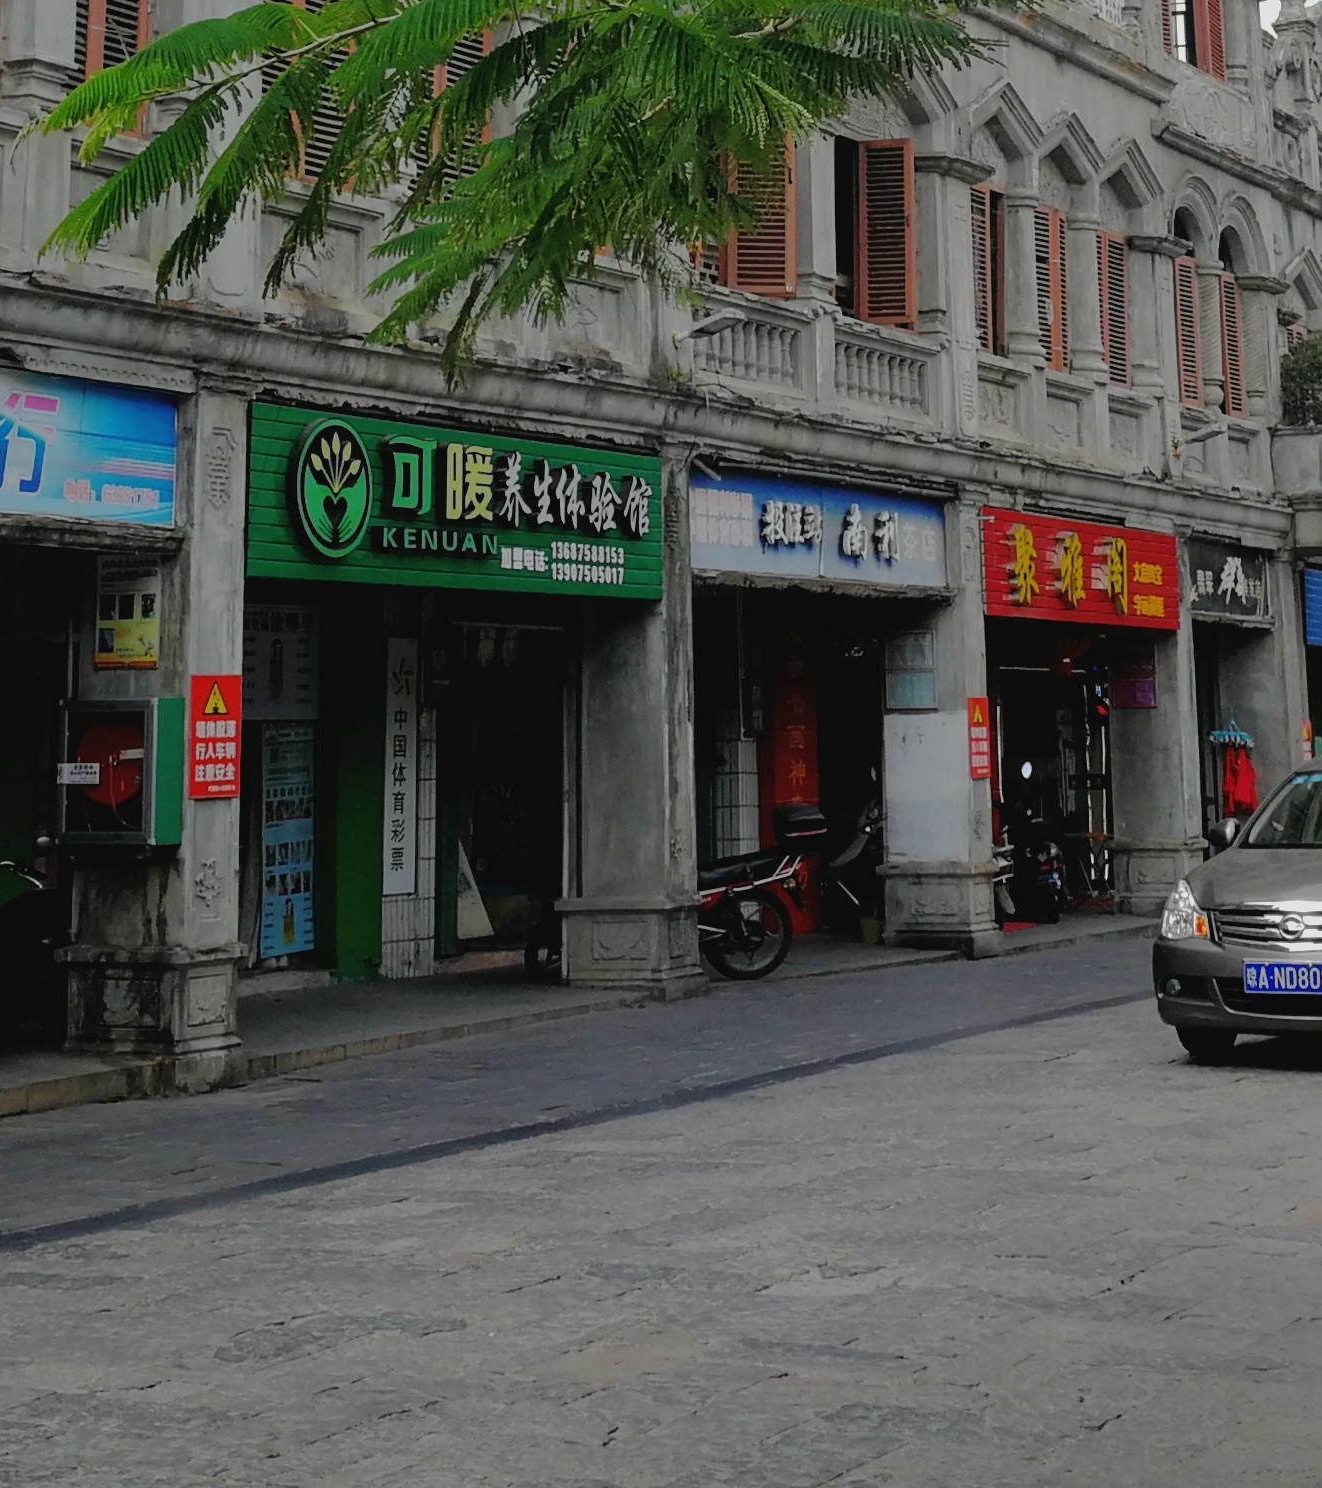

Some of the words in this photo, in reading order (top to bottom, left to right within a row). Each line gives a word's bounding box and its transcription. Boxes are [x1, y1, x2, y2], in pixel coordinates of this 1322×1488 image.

[383, 433, 653, 540] 可暖养生体验馆
[382, 527, 499, 555] KENUAN
[391, 707, 409, 872] 中国体育彩票
